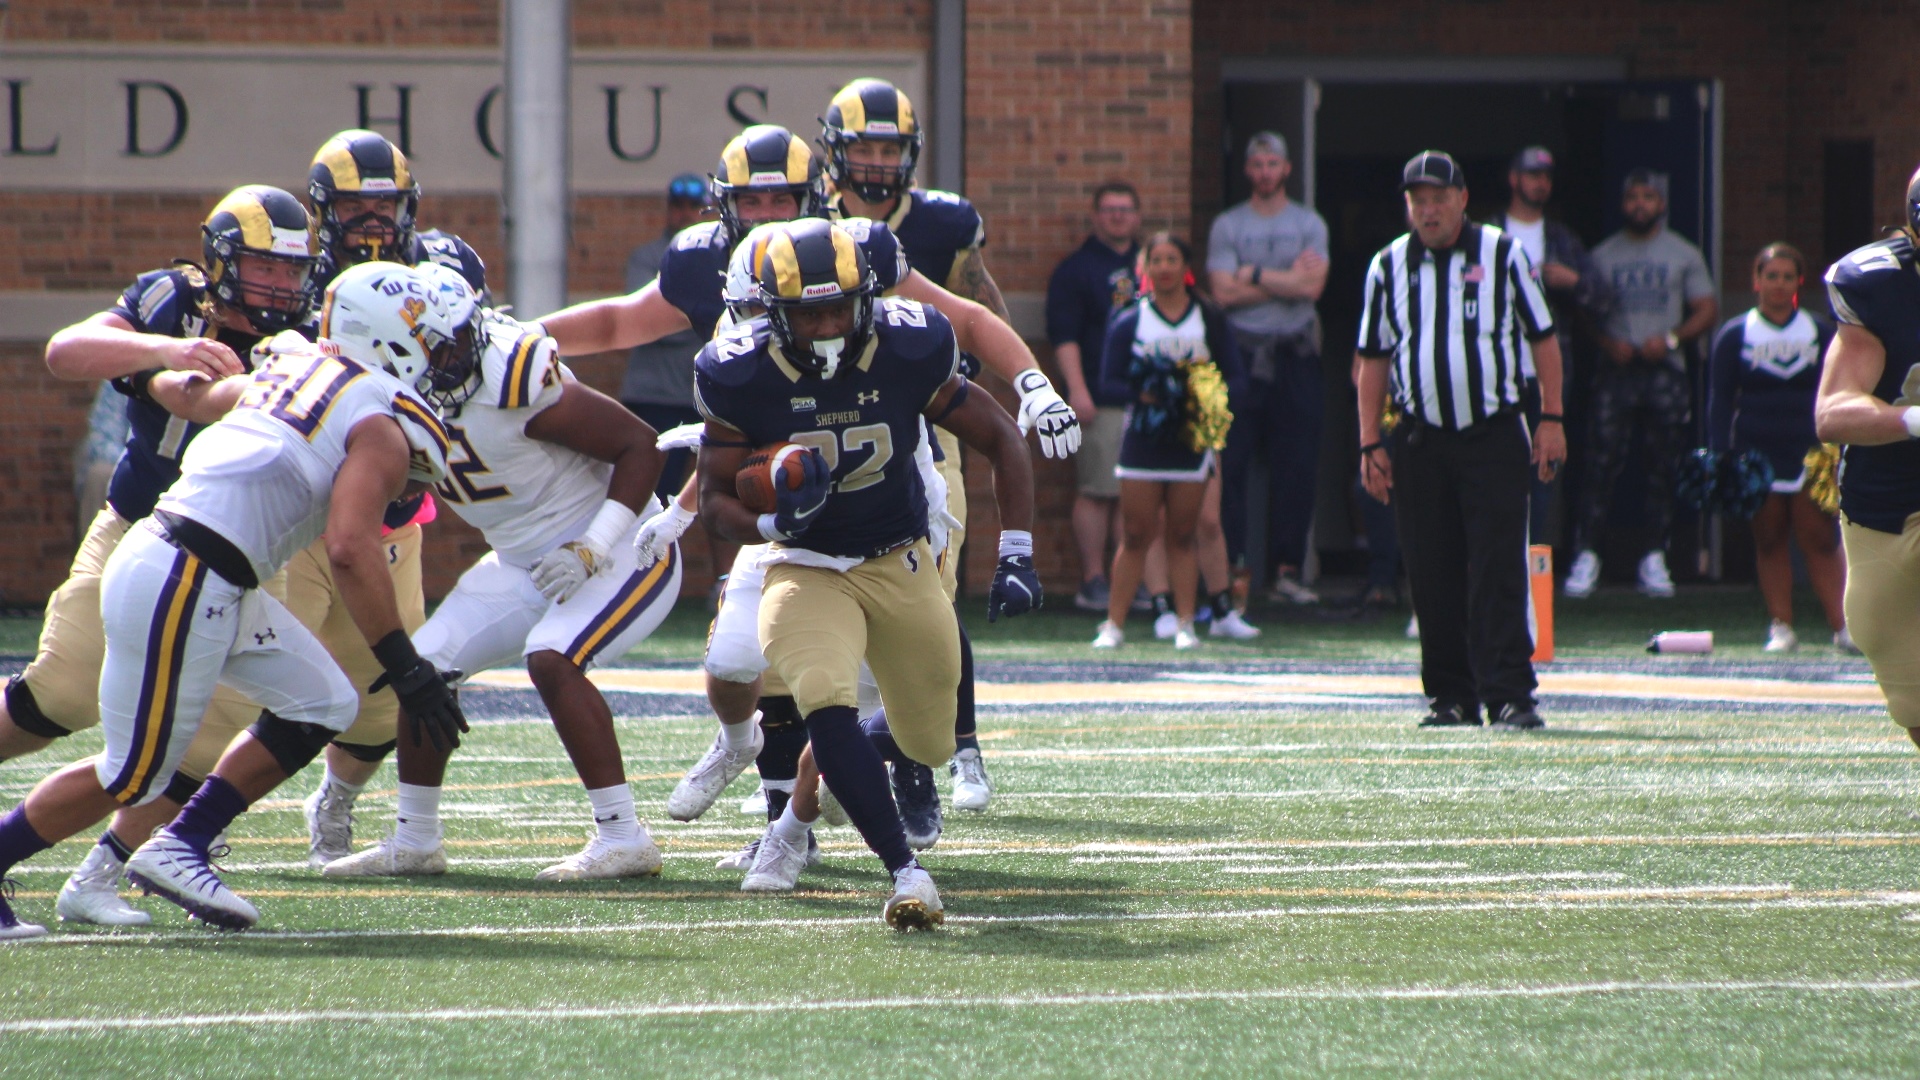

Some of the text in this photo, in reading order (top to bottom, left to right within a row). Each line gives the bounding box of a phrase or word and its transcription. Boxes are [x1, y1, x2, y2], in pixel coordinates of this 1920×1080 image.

[354, 82, 842, 160] HUS
[381, 280, 440, 308] WCU
[806, 284, 837, 296] Riddell
[882, 297, 927, 328] 22
[1464, 300, 1478, 319] U
[815, 410, 860, 427] SHEPHERD
